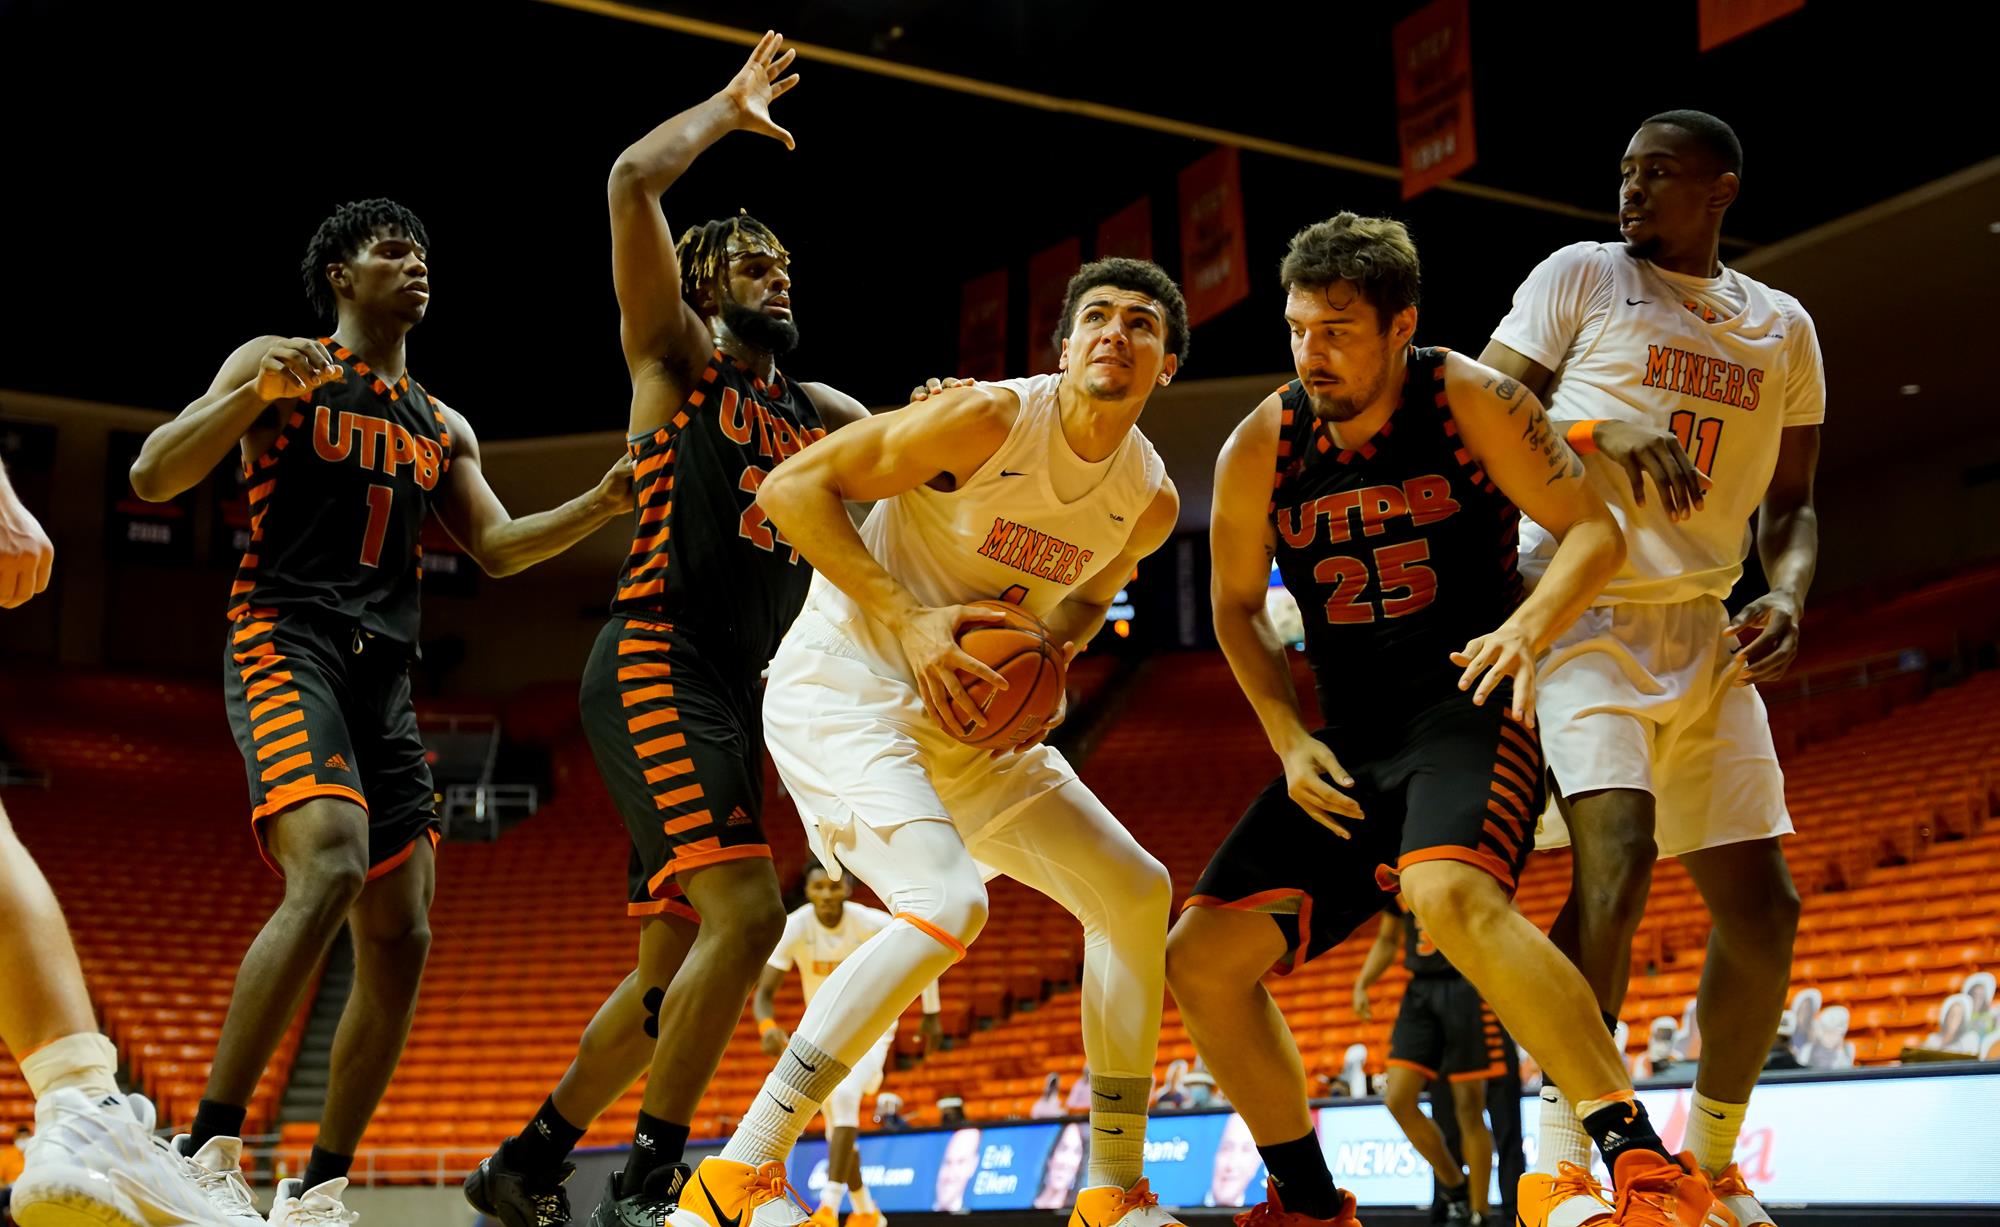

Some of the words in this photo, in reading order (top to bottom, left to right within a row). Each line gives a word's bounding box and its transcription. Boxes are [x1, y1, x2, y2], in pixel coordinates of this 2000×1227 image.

[1642, 344, 1765, 411] MINERS
[313, 405, 444, 491] UTPB
[1668, 409, 1724, 478] 11
[359, 483, 394, 569] 1
[738, 465, 802, 566] 2
[977, 516, 1095, 586] MINERS
[1277, 474, 1462, 549] UTPB
[1313, 537, 1438, 625] 25
